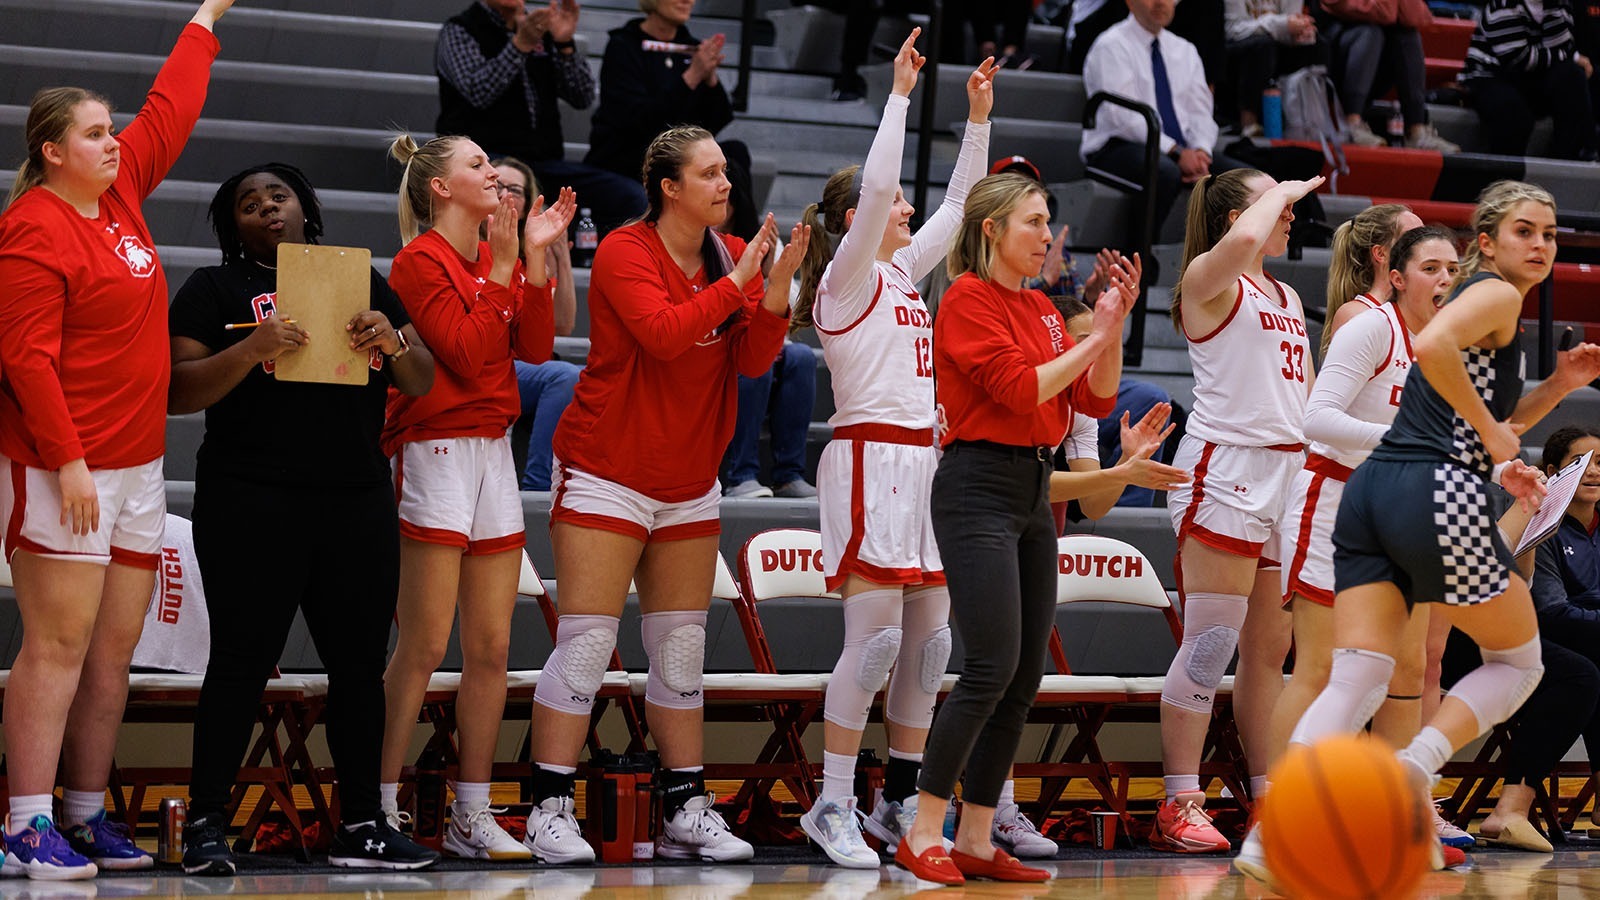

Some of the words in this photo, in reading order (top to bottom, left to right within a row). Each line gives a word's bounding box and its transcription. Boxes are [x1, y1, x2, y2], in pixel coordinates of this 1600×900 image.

[1259, 311, 1307, 338] DUTC
[914, 337, 932, 378] 12
[1280, 341, 1305, 384] 33
[161, 547, 184, 625] DUTCH
[1058, 553, 1143, 578] DUTCH
